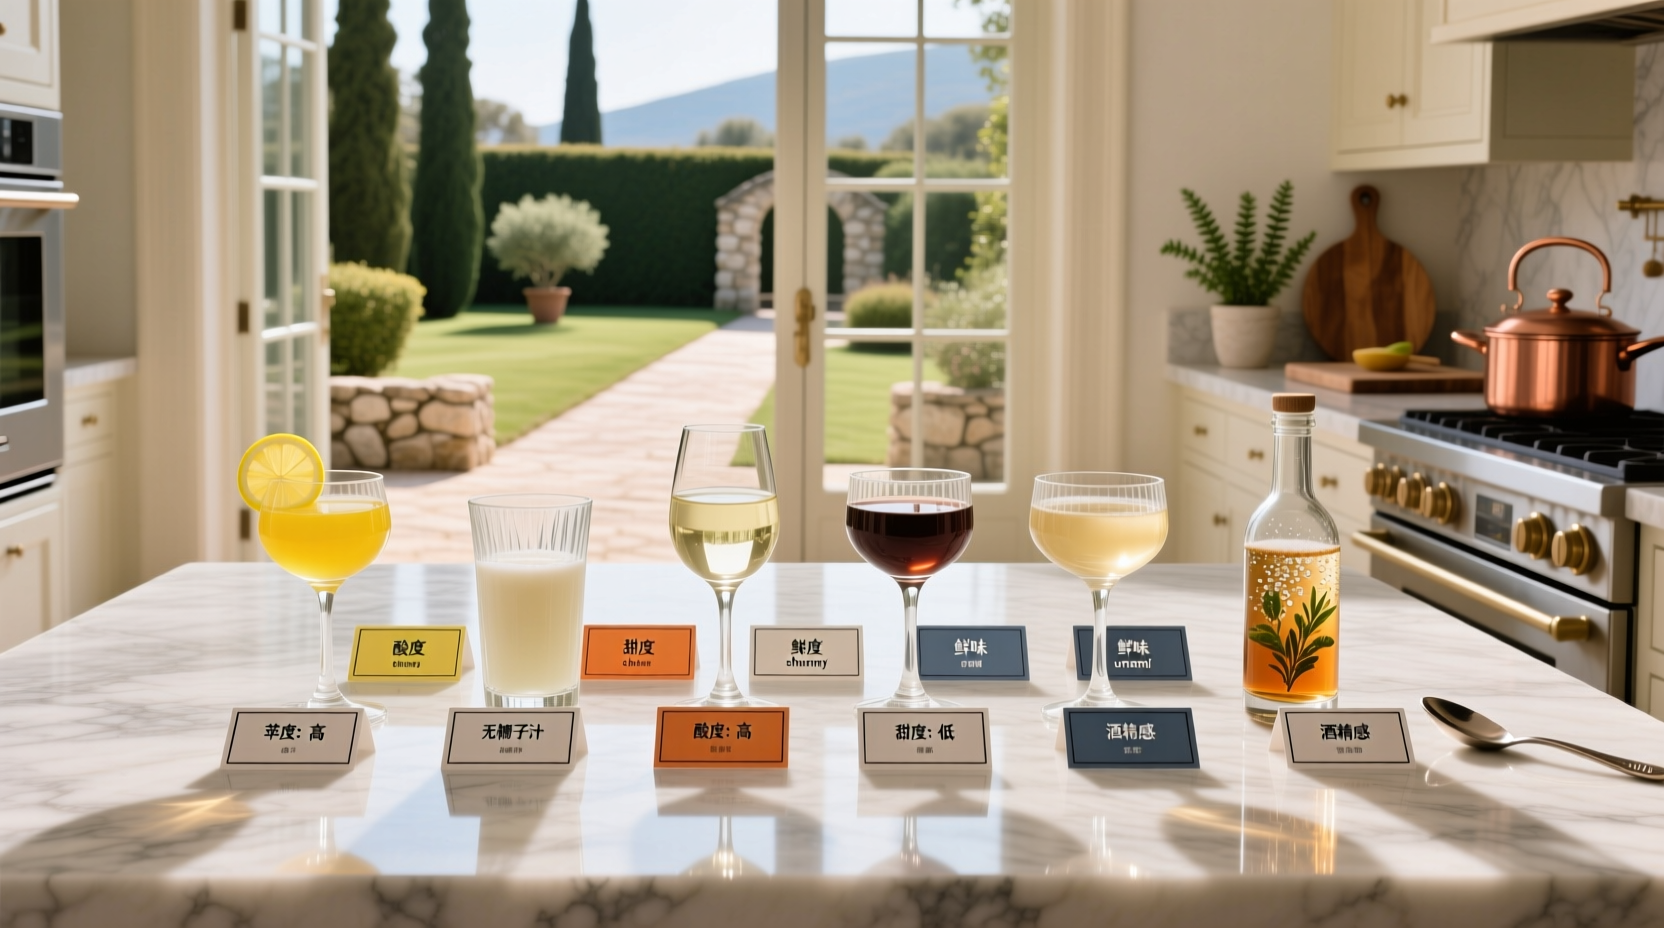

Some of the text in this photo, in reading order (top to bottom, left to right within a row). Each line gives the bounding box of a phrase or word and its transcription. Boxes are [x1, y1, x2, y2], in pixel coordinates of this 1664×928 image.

[622, 638, 655, 656] 甜度
[954, 638, 988, 656] 鲜味
[1117, 638, 1150, 657] 鲜味
[1105, 722, 1156, 741] 酒精感
[1320, 723, 1370, 741] 酒精感
